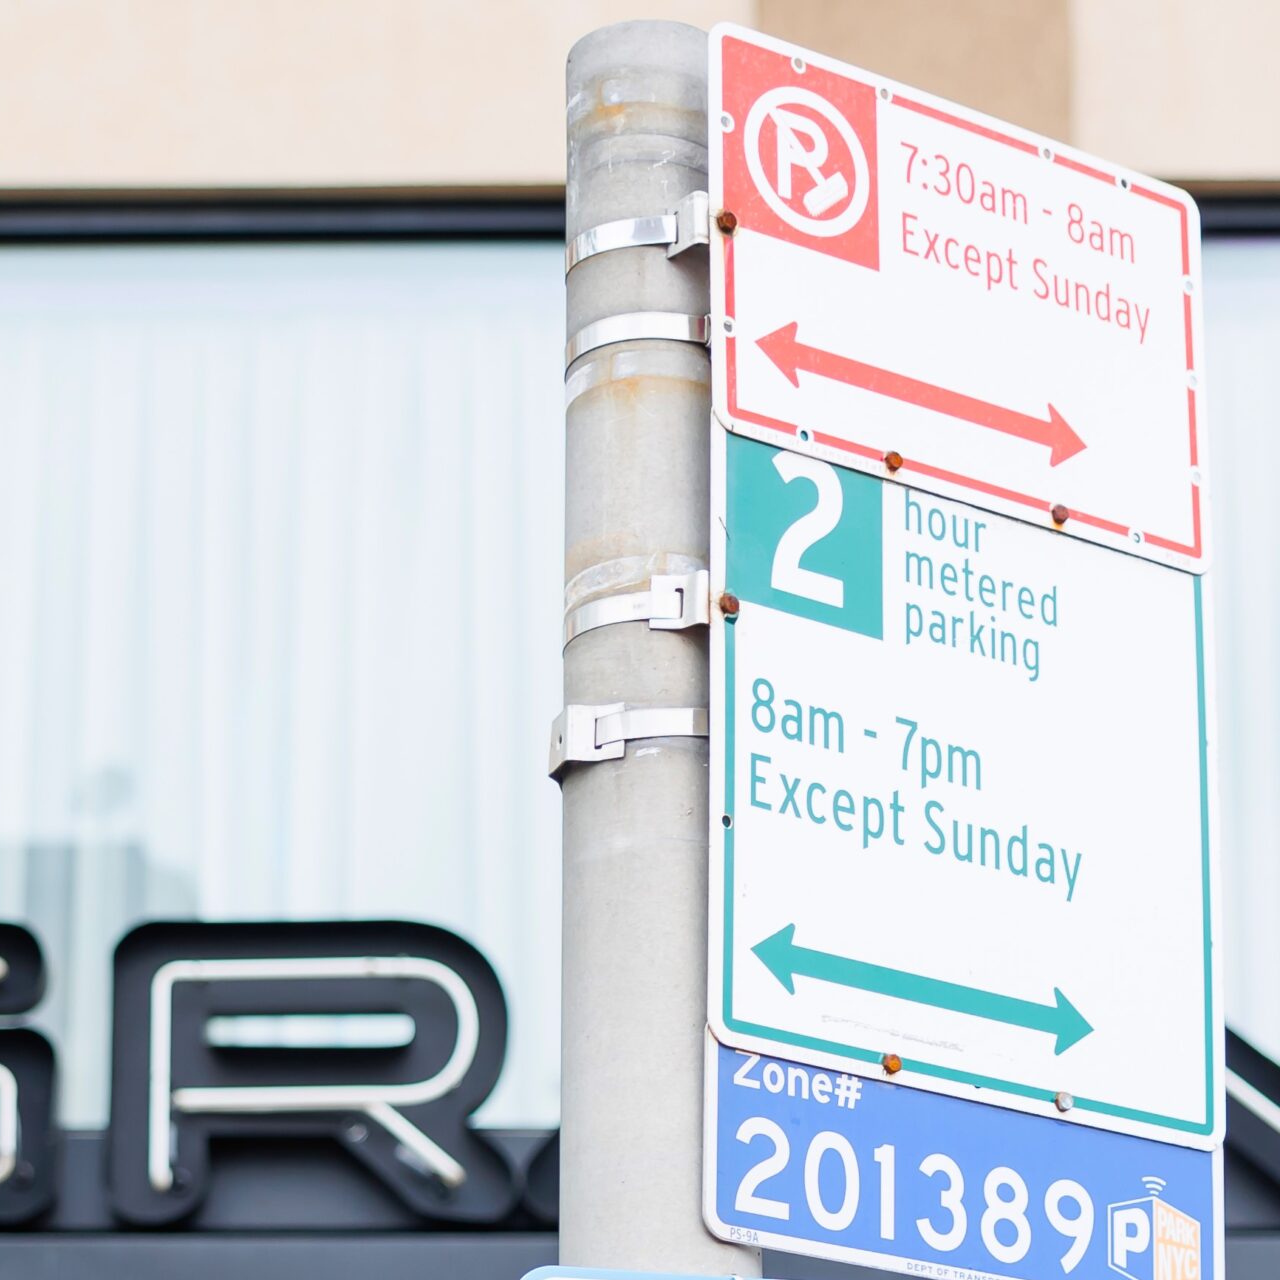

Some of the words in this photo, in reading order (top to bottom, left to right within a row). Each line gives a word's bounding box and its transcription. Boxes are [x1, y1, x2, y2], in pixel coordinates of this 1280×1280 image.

[899, 141, 1029, 225] 7:30am
[1067, 203, 1136, 264] 8am
[901, 211, 1019, 291] Except
[1032, 258, 1151, 344] Sunday
[771, 450, 844, 609] 2
[904, 487, 987, 553] hour
[905, 549, 1058, 627] metered
[906, 601, 1041, 682] parking
[750, 678, 845, 753] 8am
[895, 716, 982, 790] 7pm
[749, 752, 906, 849] Except
[923, 799, 1082, 902] Sunday
[732, 1050, 863, 1109] Zone#
[729, 1226, 760, 1243] PS-9A
[733, 1115, 1095, 1274] 201389
[1158, 1205, 1197, 1248] PARK
[906, 1261, 935, 1275] DEPT
[936, 1266, 951, 1277] OF
